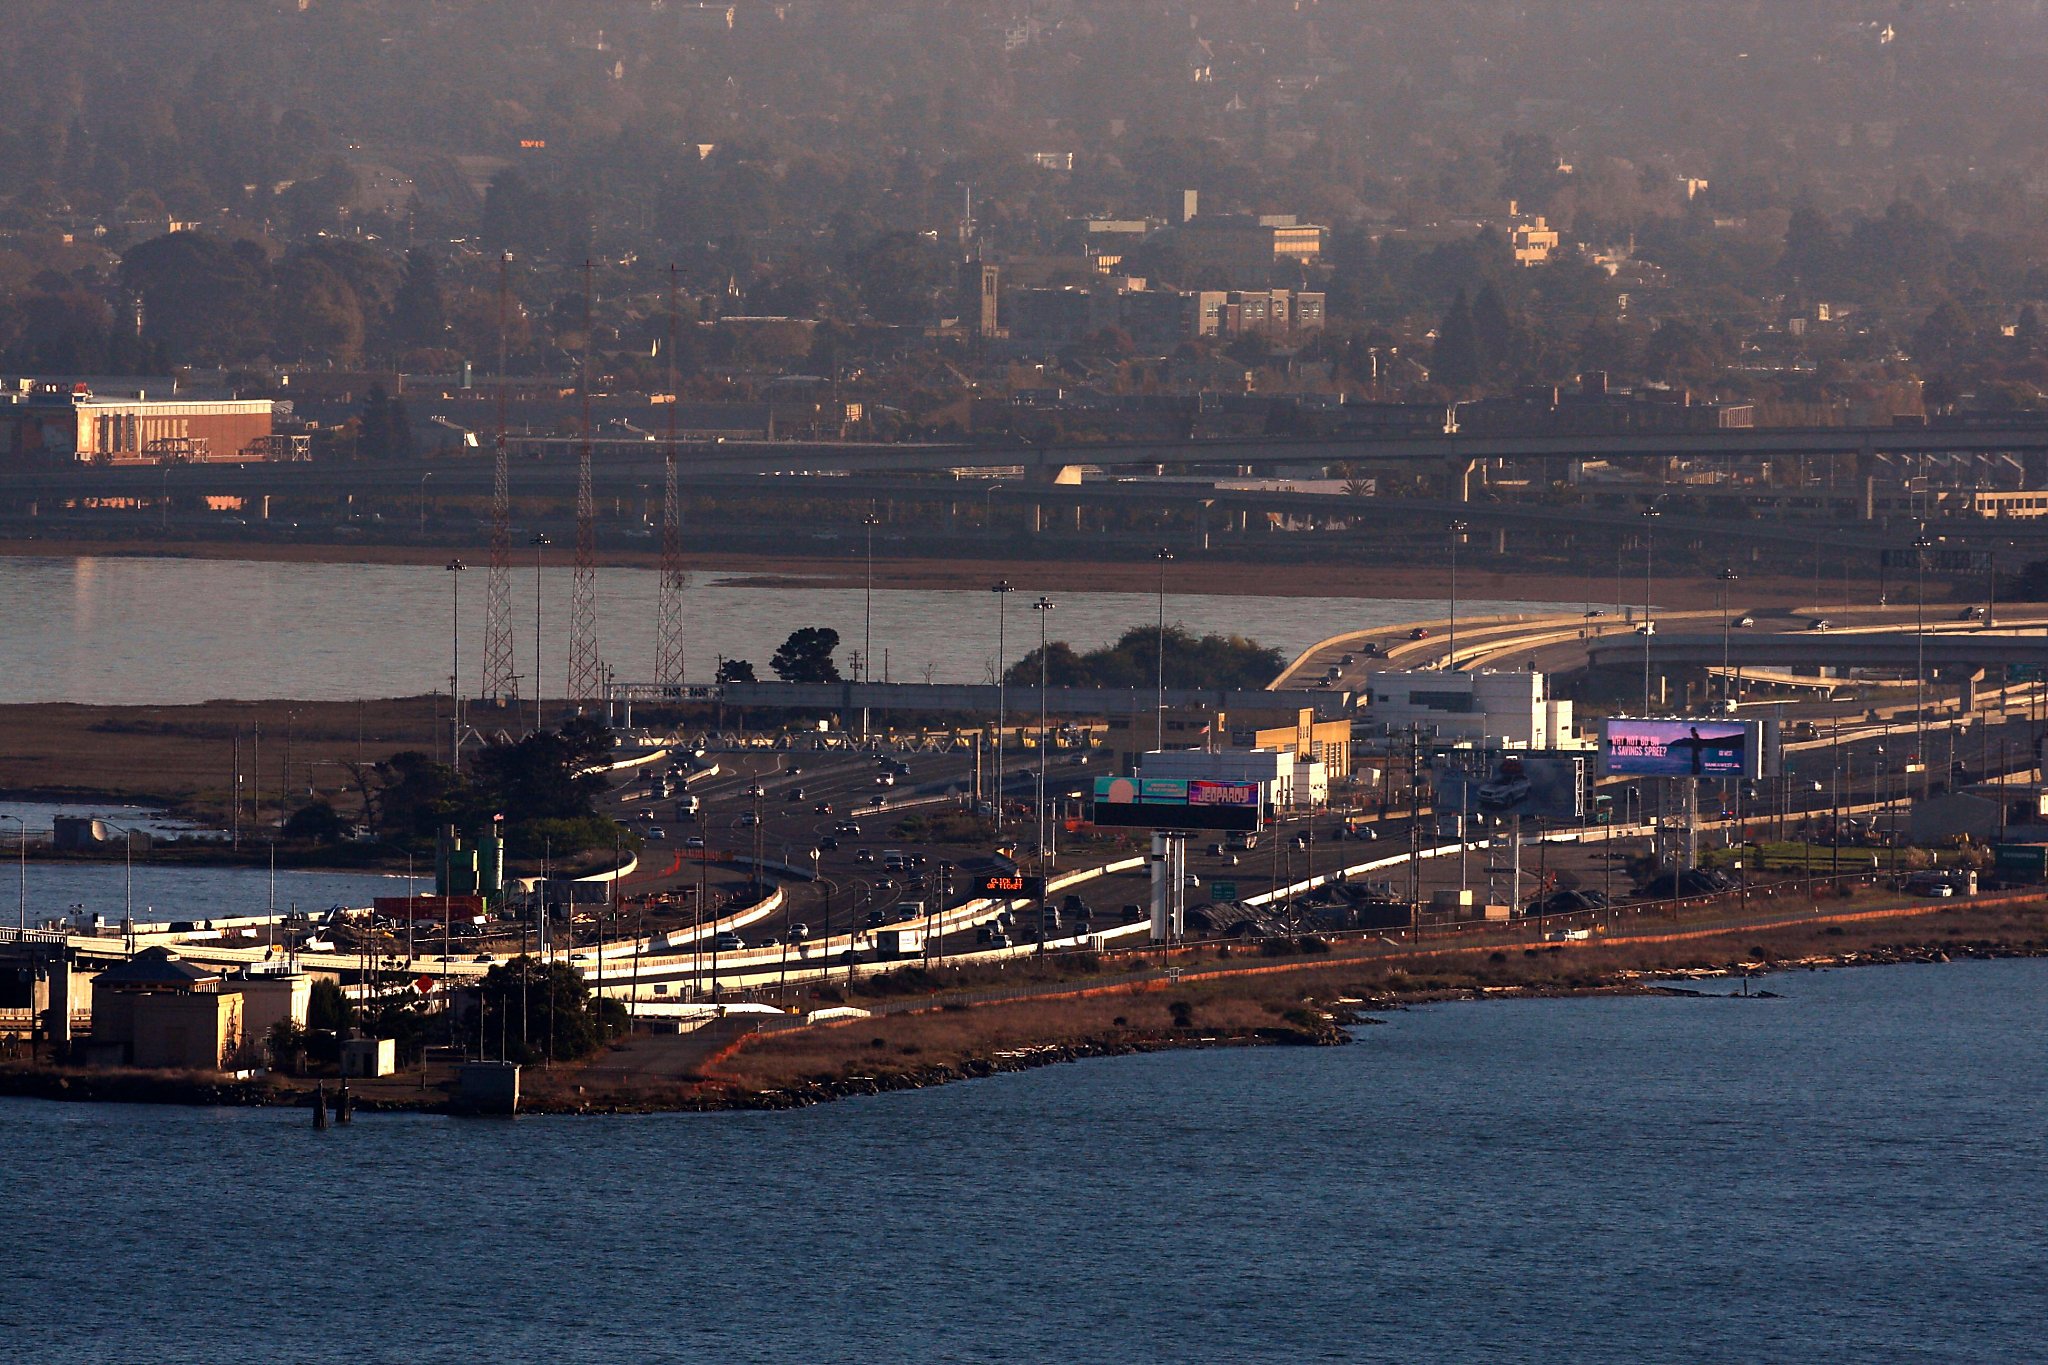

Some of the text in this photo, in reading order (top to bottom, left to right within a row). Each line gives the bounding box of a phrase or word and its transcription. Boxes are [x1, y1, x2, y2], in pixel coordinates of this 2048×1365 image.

[1626, 736, 1638, 746] NOT
[1640, 736, 1649, 746] GO
[1611, 746, 1667, 757] A SAVINGS SPREE?
